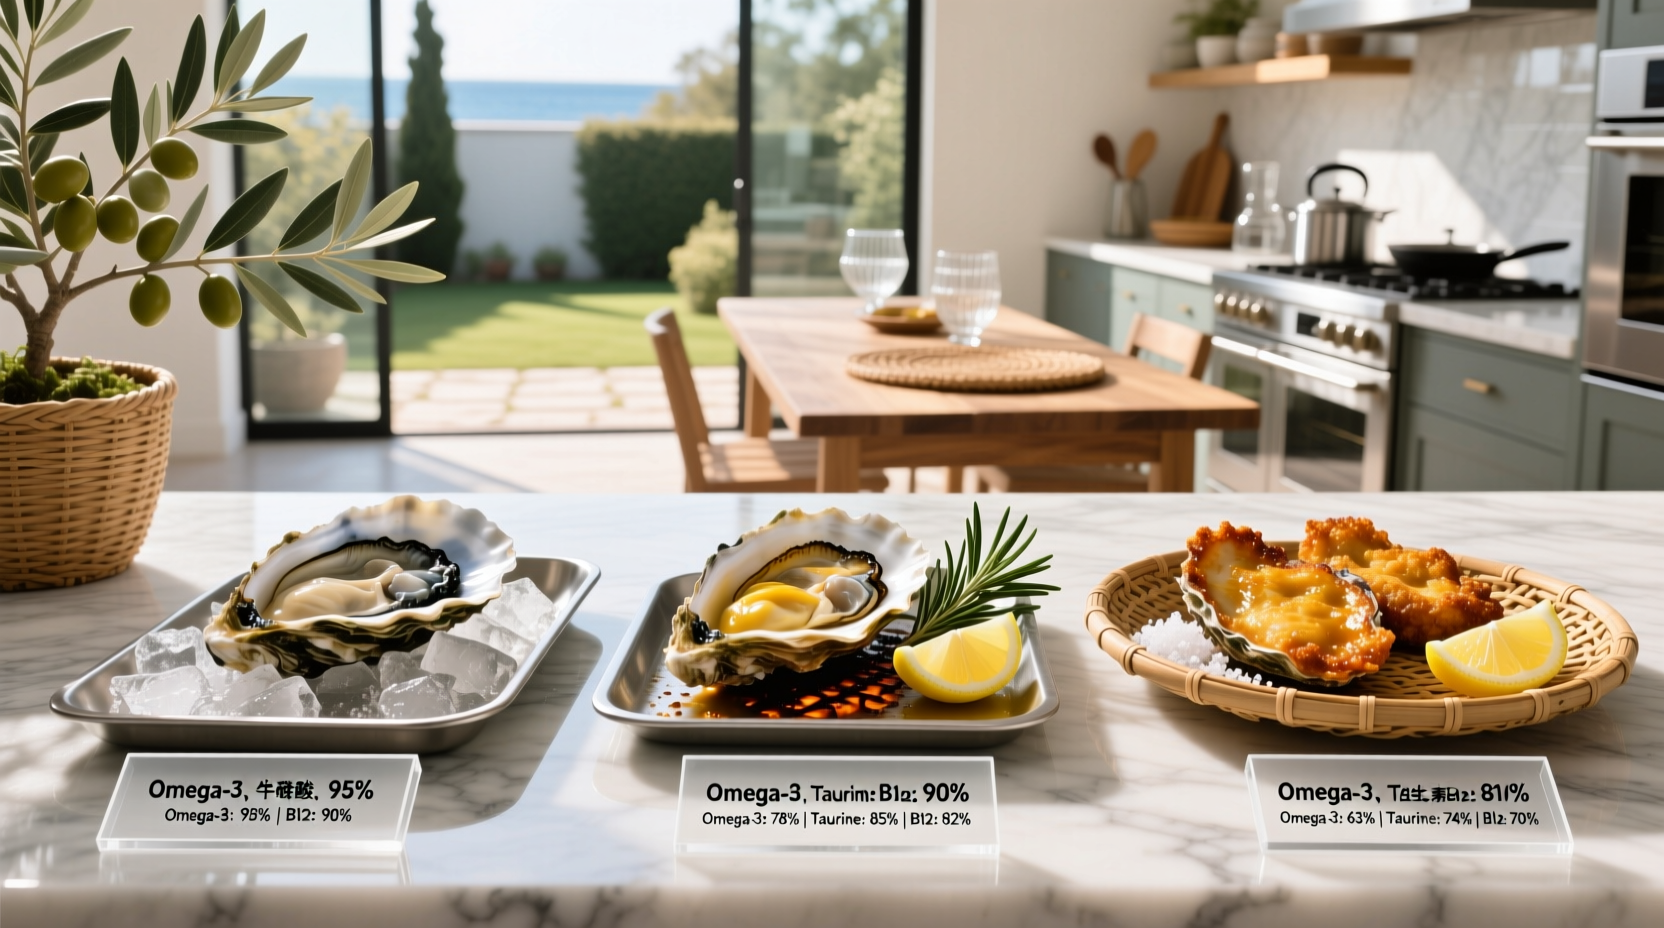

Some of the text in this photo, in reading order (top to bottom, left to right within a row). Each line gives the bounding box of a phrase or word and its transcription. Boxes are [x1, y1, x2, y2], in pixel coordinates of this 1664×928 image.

[149, 779, 249, 803] Omega-3,
[329, 779, 374, 800] 95%
[707, 782, 807, 806] Omega-3,
[923, 782, 970, 803] 90%
[1278, 782, 1381, 805] Omega-3,
[165, 808, 234, 825] Omega-3:
[322, 808, 352, 822] 90%
[702, 811, 767, 828] Omega-3:
[771, 812, 800, 825] 78%
[811, 812, 866, 825] Taurine:
[870, 812, 899, 825] 85%
[911, 812, 938, 825] B12:
[943, 812, 971, 825] 82%
[1280, 811, 1343, 827] Omega-3:
[1347, 811, 1376, 824] 63%
[1386, 811, 1441, 825] Taurine:
[1443, 811, 1473, 825] 74%
[1510, 811, 1540, 825] 70%
